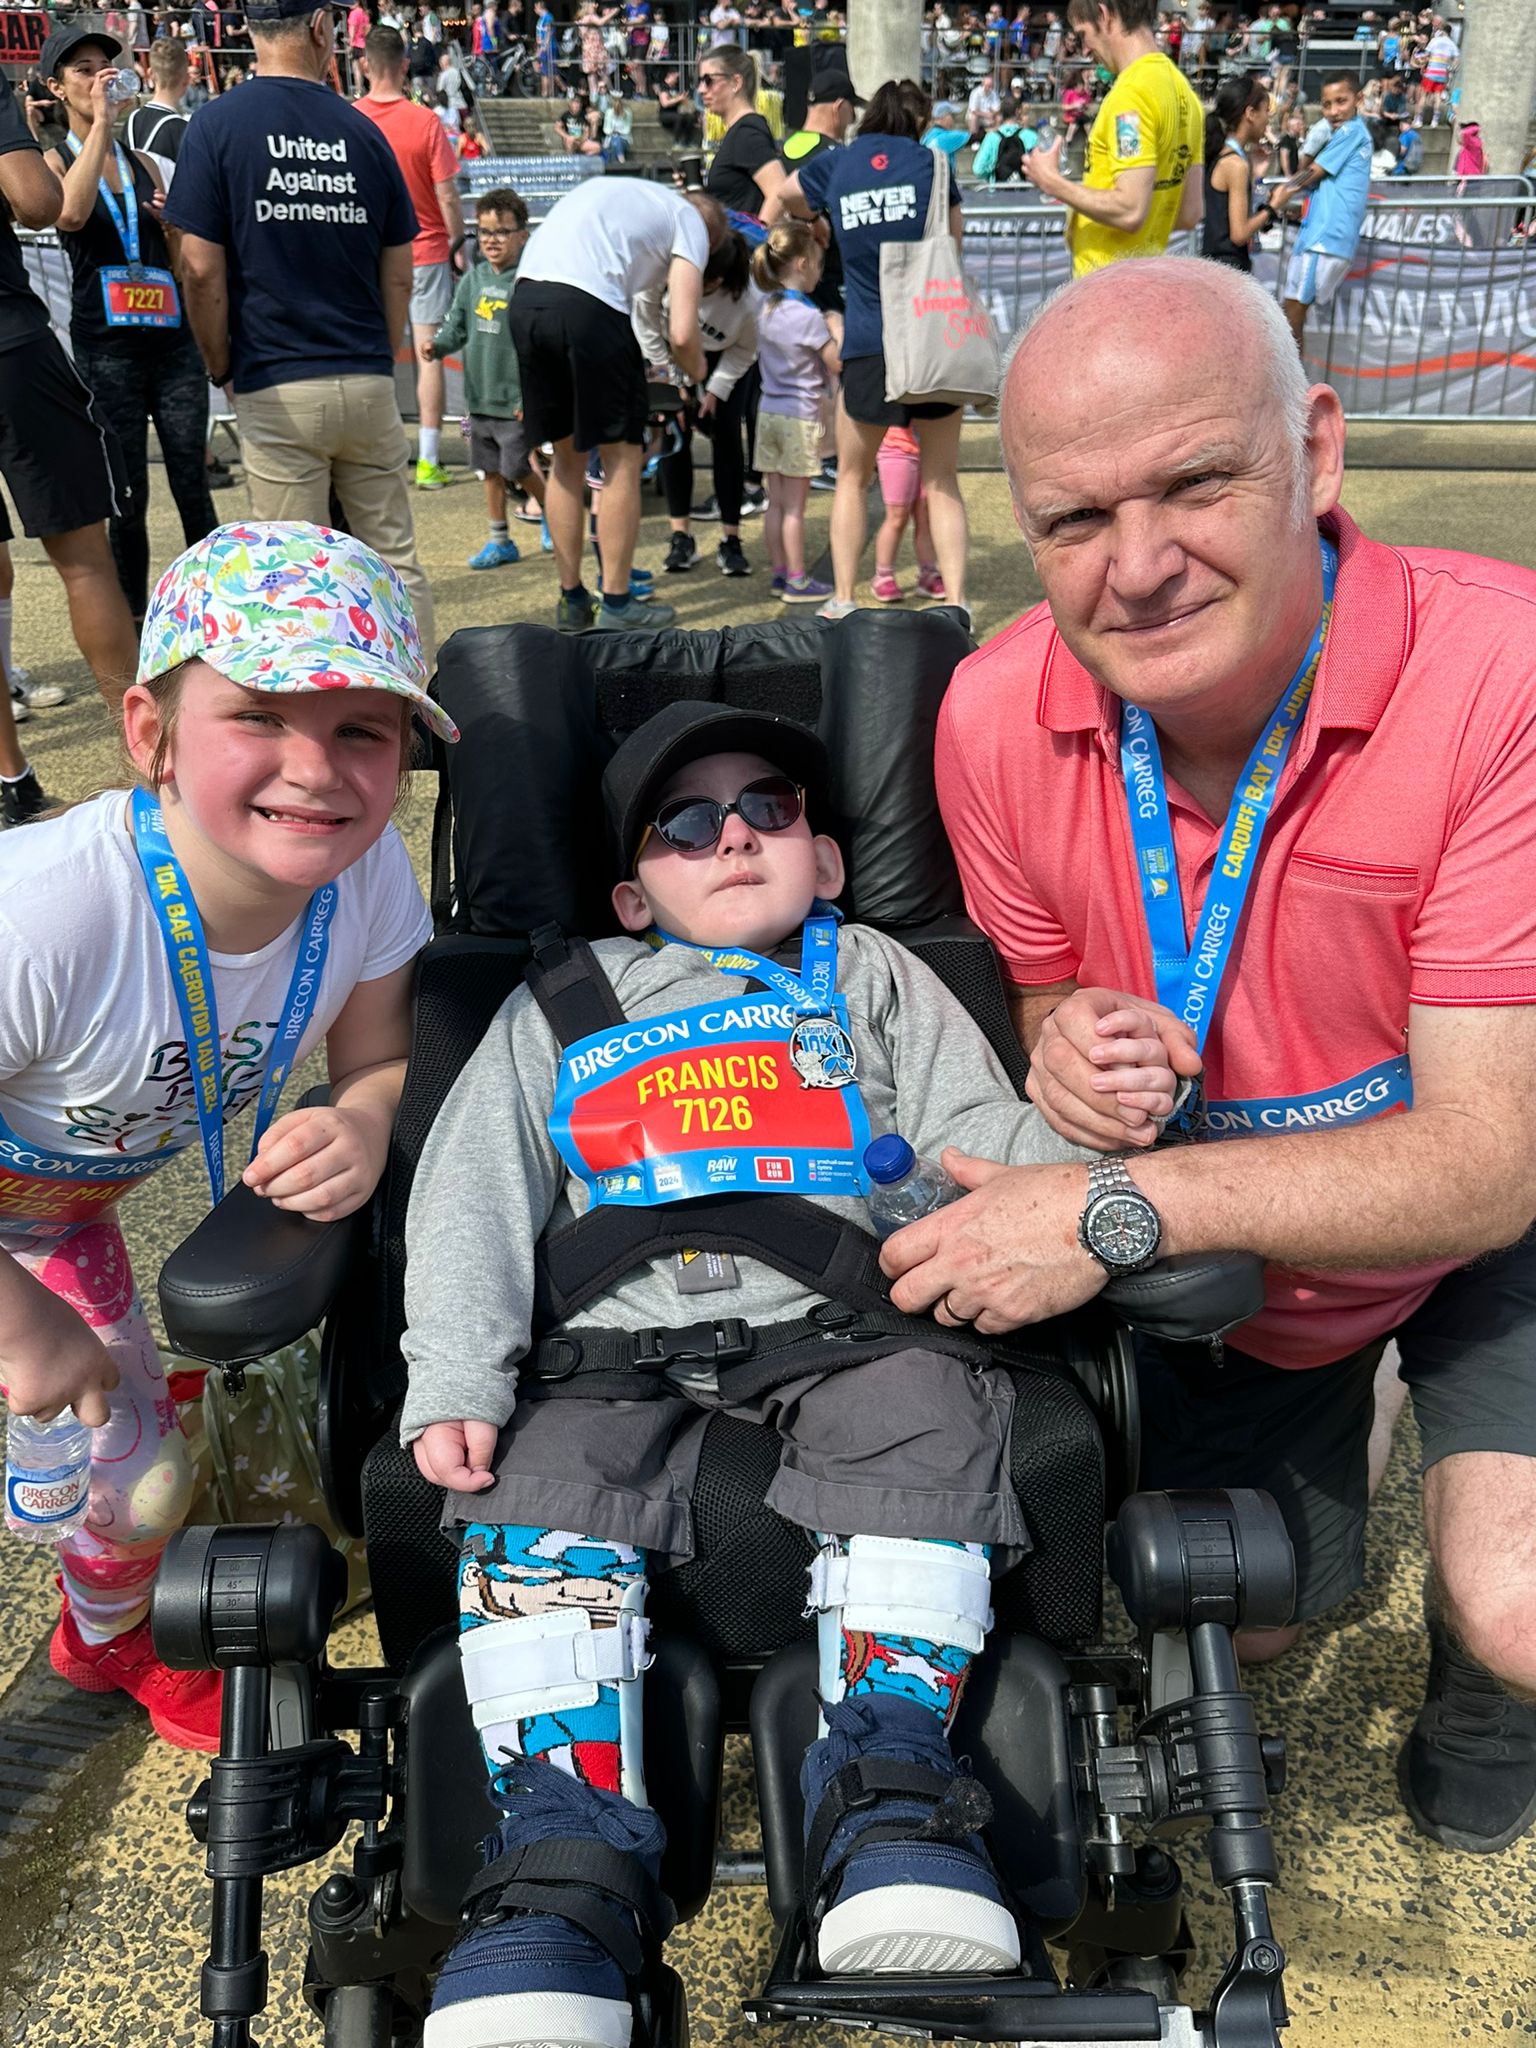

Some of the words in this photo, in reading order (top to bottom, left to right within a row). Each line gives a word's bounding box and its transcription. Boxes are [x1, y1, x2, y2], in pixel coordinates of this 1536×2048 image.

[266, 134, 348, 163] United
[265, 167, 358, 196] Against
[254, 199, 369, 224] Dementia
[839, 184, 917, 215] NEVER
[123, 287, 164, 310] 7227
[1129, 738, 1159, 819] CARREG
[1222, 803, 1257, 879] CARDIFF
[1243, 760, 1273, 802] BAY
[1262, 721, 1291, 758] 10K
[154, 863, 182, 900] 10K
[166, 903, 195, 944] BAE
[1195, 902, 1231, 979] CARREG
[284, 968, 316, 1040] BRECON
[306, 887, 334, 964] CARREG
[178, 947, 211, 1038] CAERDYDD
[196, 1038, 216, 1072] IAU
[568, 1019, 691, 1084] BRECON
[699, 1003, 795, 1034] CARRE
[798, 1034, 838, 1056] 10K
[201, 1072, 219, 1115] 2024
[637, 1055, 779, 1105] FRANCIS
[673, 1095, 754, 1134] 7126
[1260, 1077, 1391, 1128] CARREG
[658, 1176, 679, 1187] 2024
[706, 1158, 738, 1173] R4W
[766, 1161, 782, 1170] FUN
[767, 1170, 783, 1179] RUN
[21, 1490, 79, 1509] CARREG
[22, 1479, 80, 1499] BRECON
